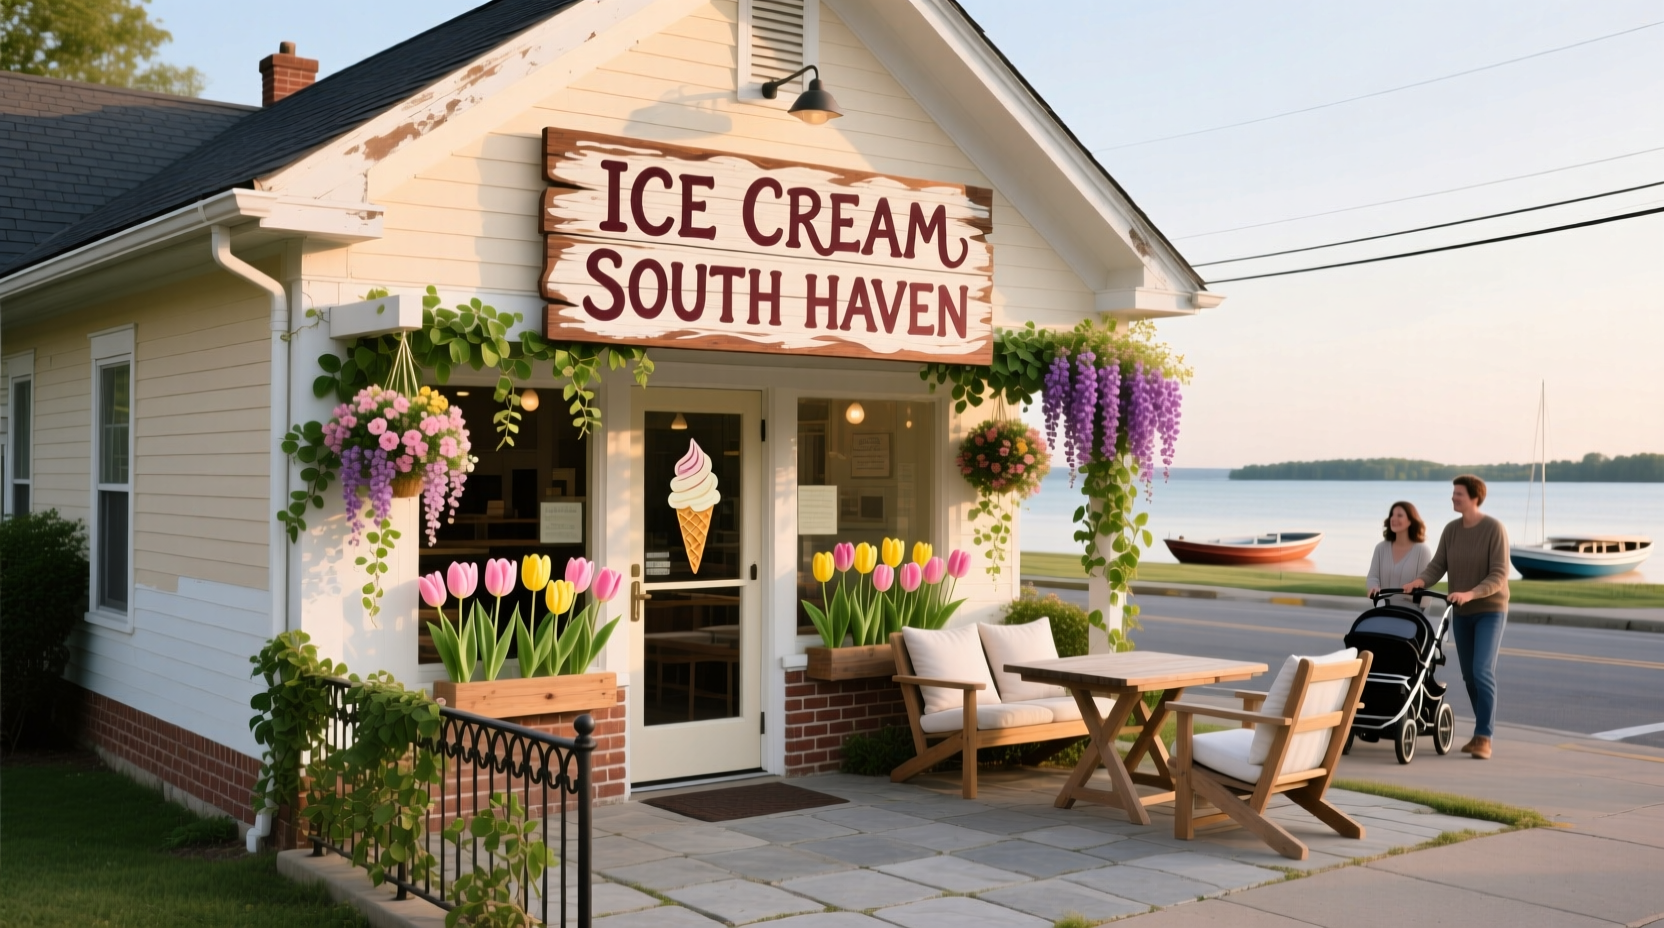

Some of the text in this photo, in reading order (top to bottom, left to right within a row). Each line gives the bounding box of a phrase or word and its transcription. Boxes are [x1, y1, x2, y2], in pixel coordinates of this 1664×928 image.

[599, 159, 969, 269] ICE CREAM
[582, 247, 969, 339] SOUTH HAVEN
